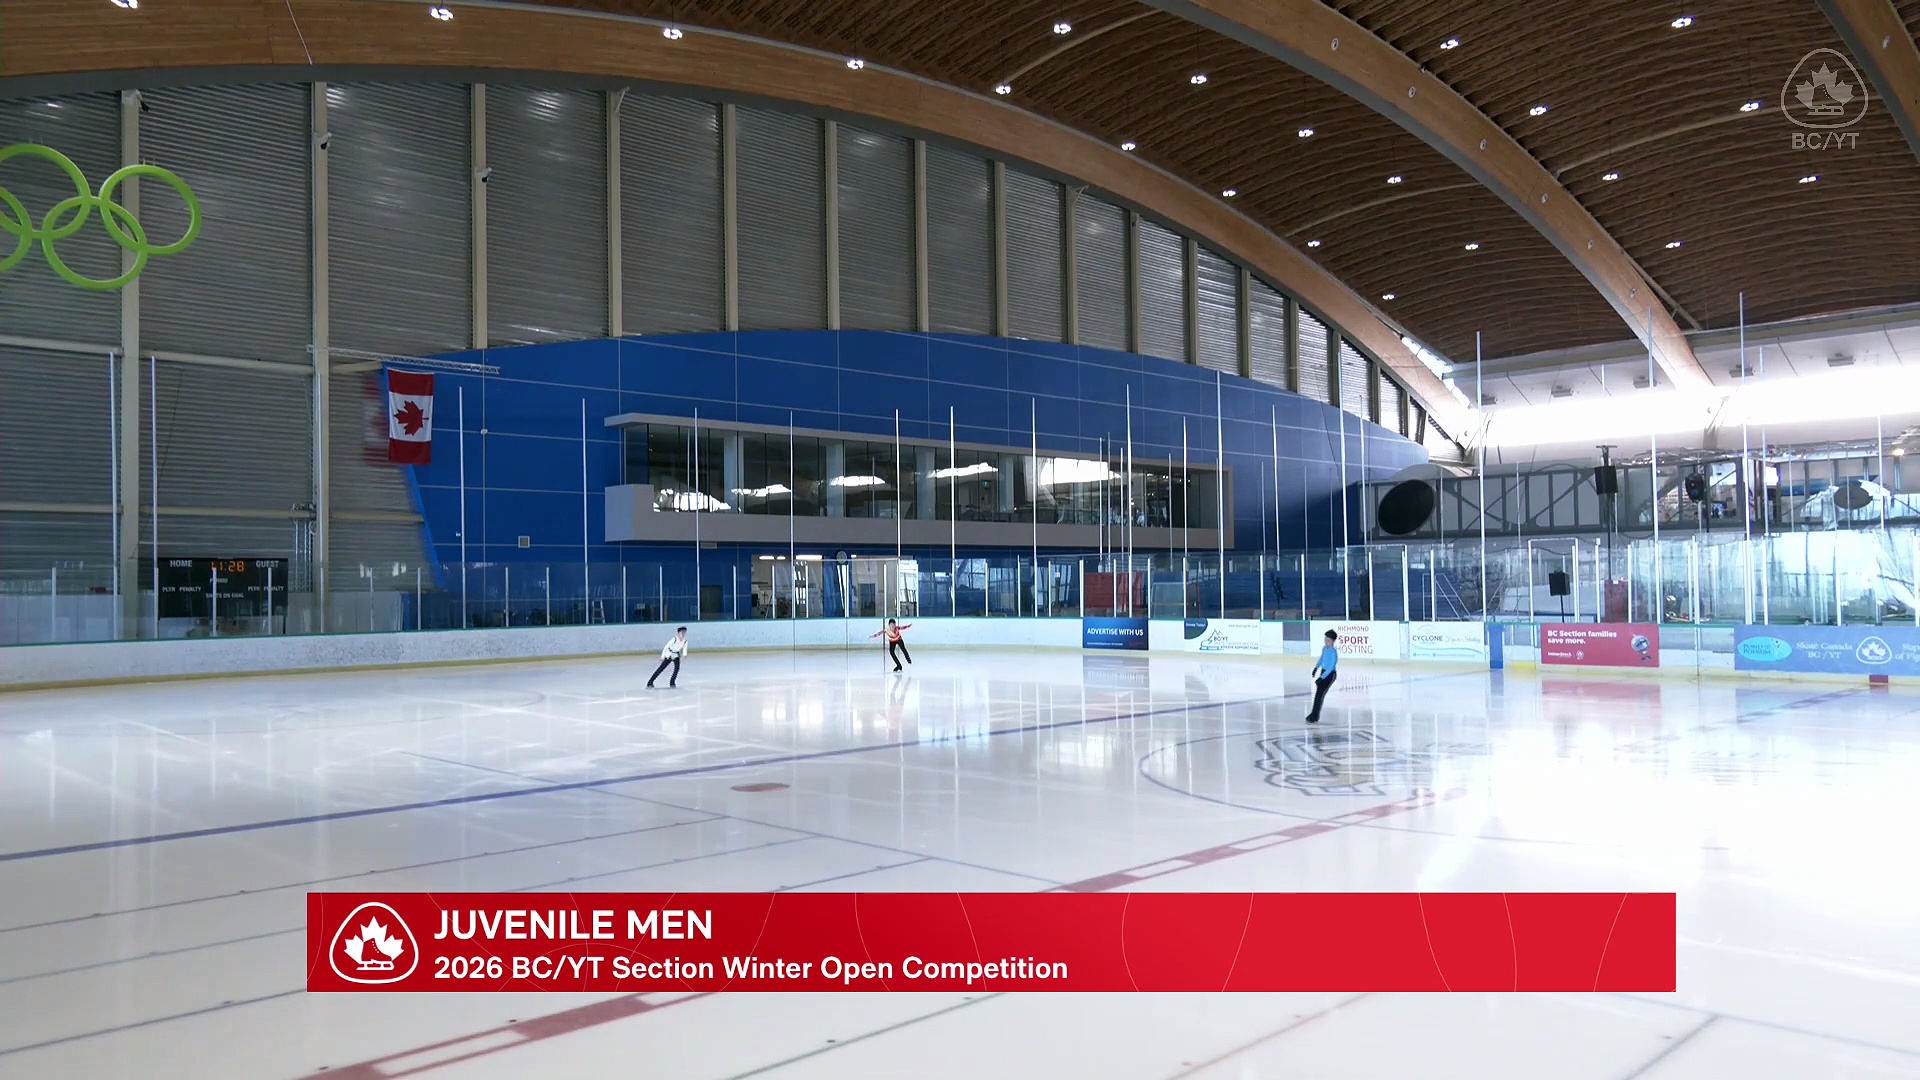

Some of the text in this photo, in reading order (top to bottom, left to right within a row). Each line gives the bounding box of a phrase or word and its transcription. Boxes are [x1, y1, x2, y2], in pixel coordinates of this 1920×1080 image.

[169, 559, 193, 568] HOME
[255, 559, 280, 569] GUEST
[1086, 627, 1144, 637] ADVERTISE WITH US
[1559, 630, 1587, 638] Section
[1587, 630, 1617, 638] families
[1338, 635, 1369, 645] SPORT
[1796, 641, 1853, 651] Skate Canada
